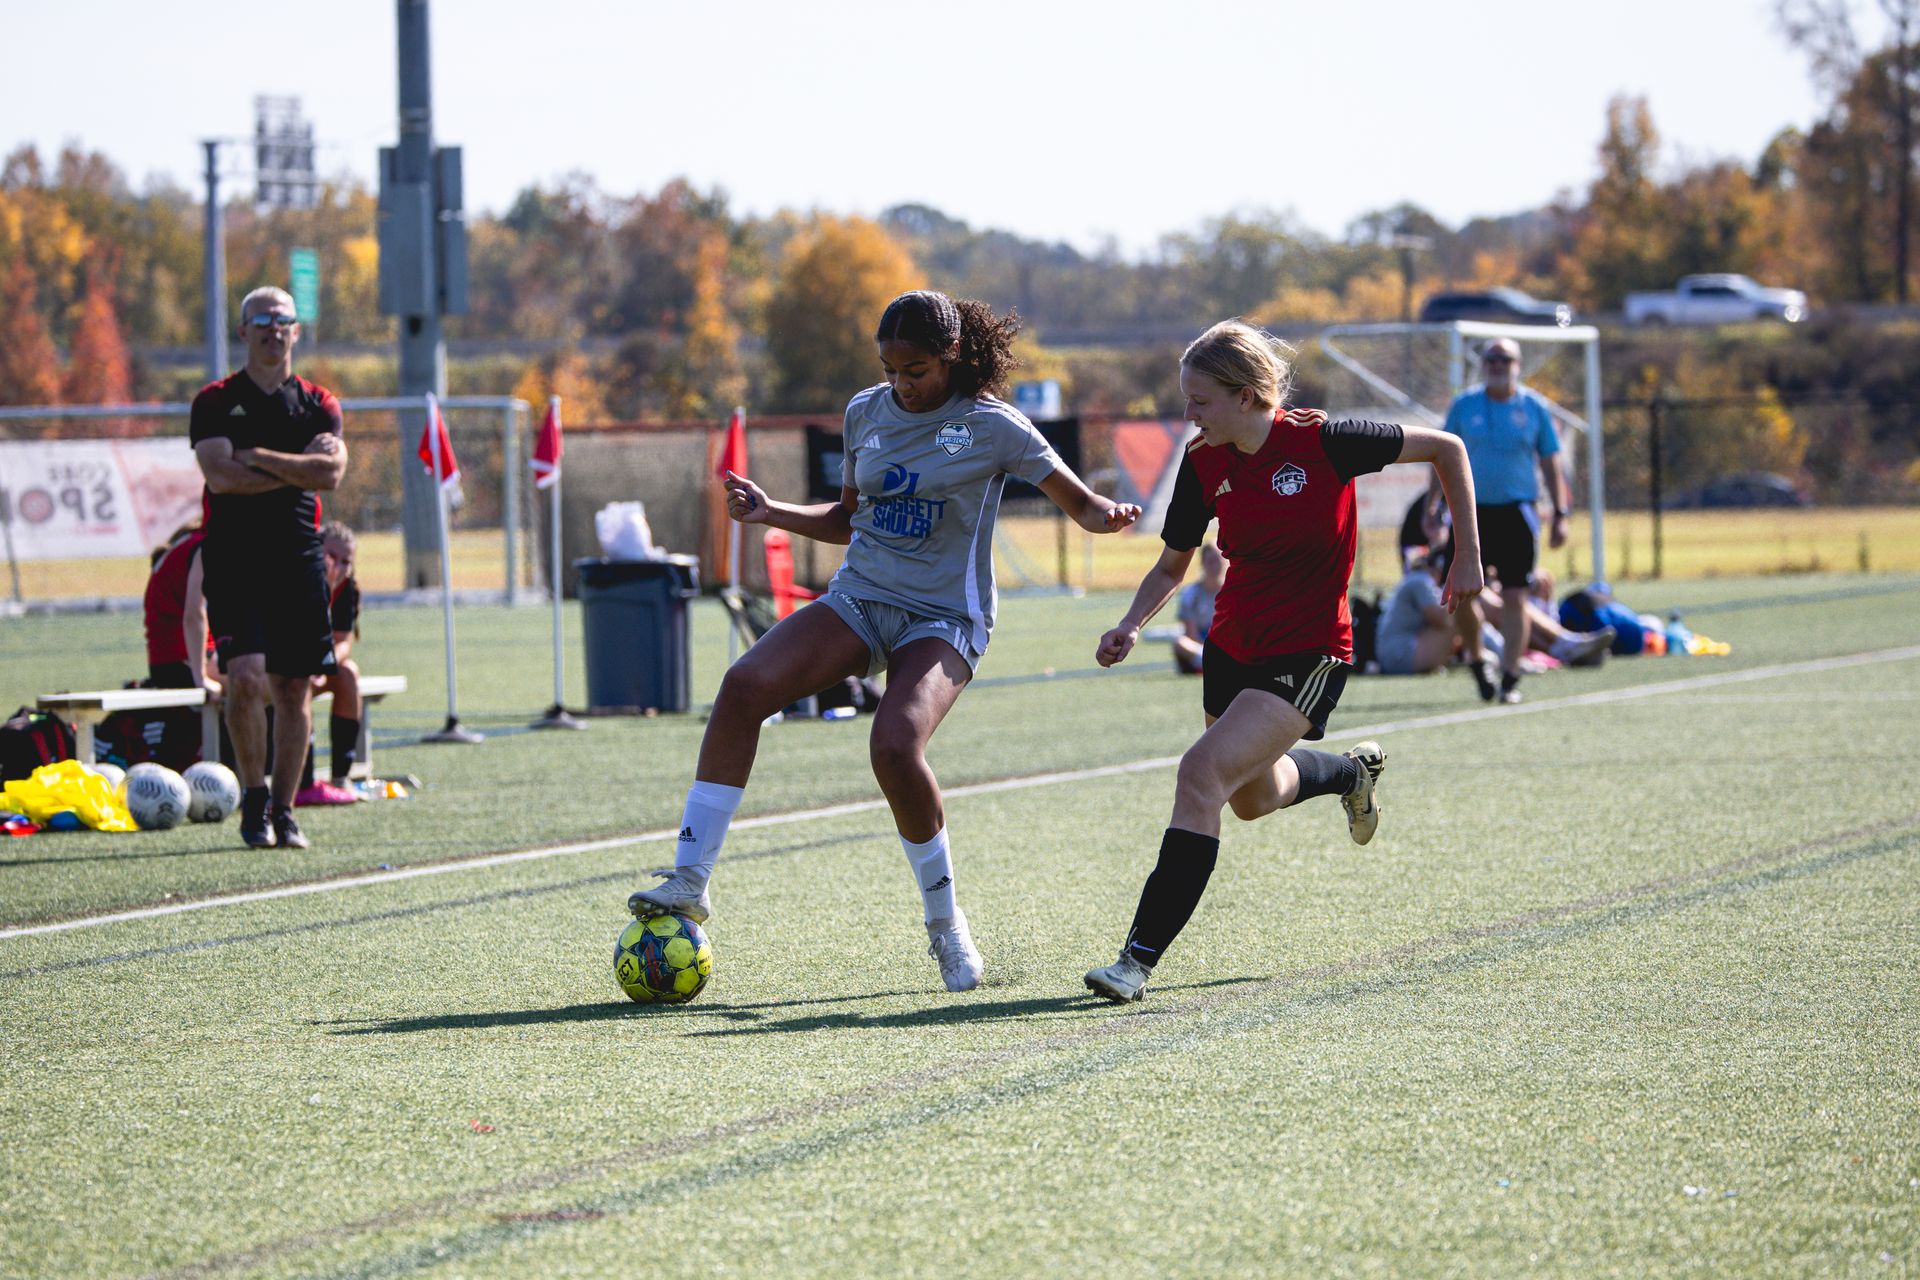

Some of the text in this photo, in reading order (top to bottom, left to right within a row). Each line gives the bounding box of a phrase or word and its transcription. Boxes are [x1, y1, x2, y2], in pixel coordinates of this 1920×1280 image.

[938, 436, 971, 447] FUSION
[1273, 474, 1305, 488] HFC
[868, 495, 947, 519] AGGETT
[873, 505, 932, 538] SHULER
